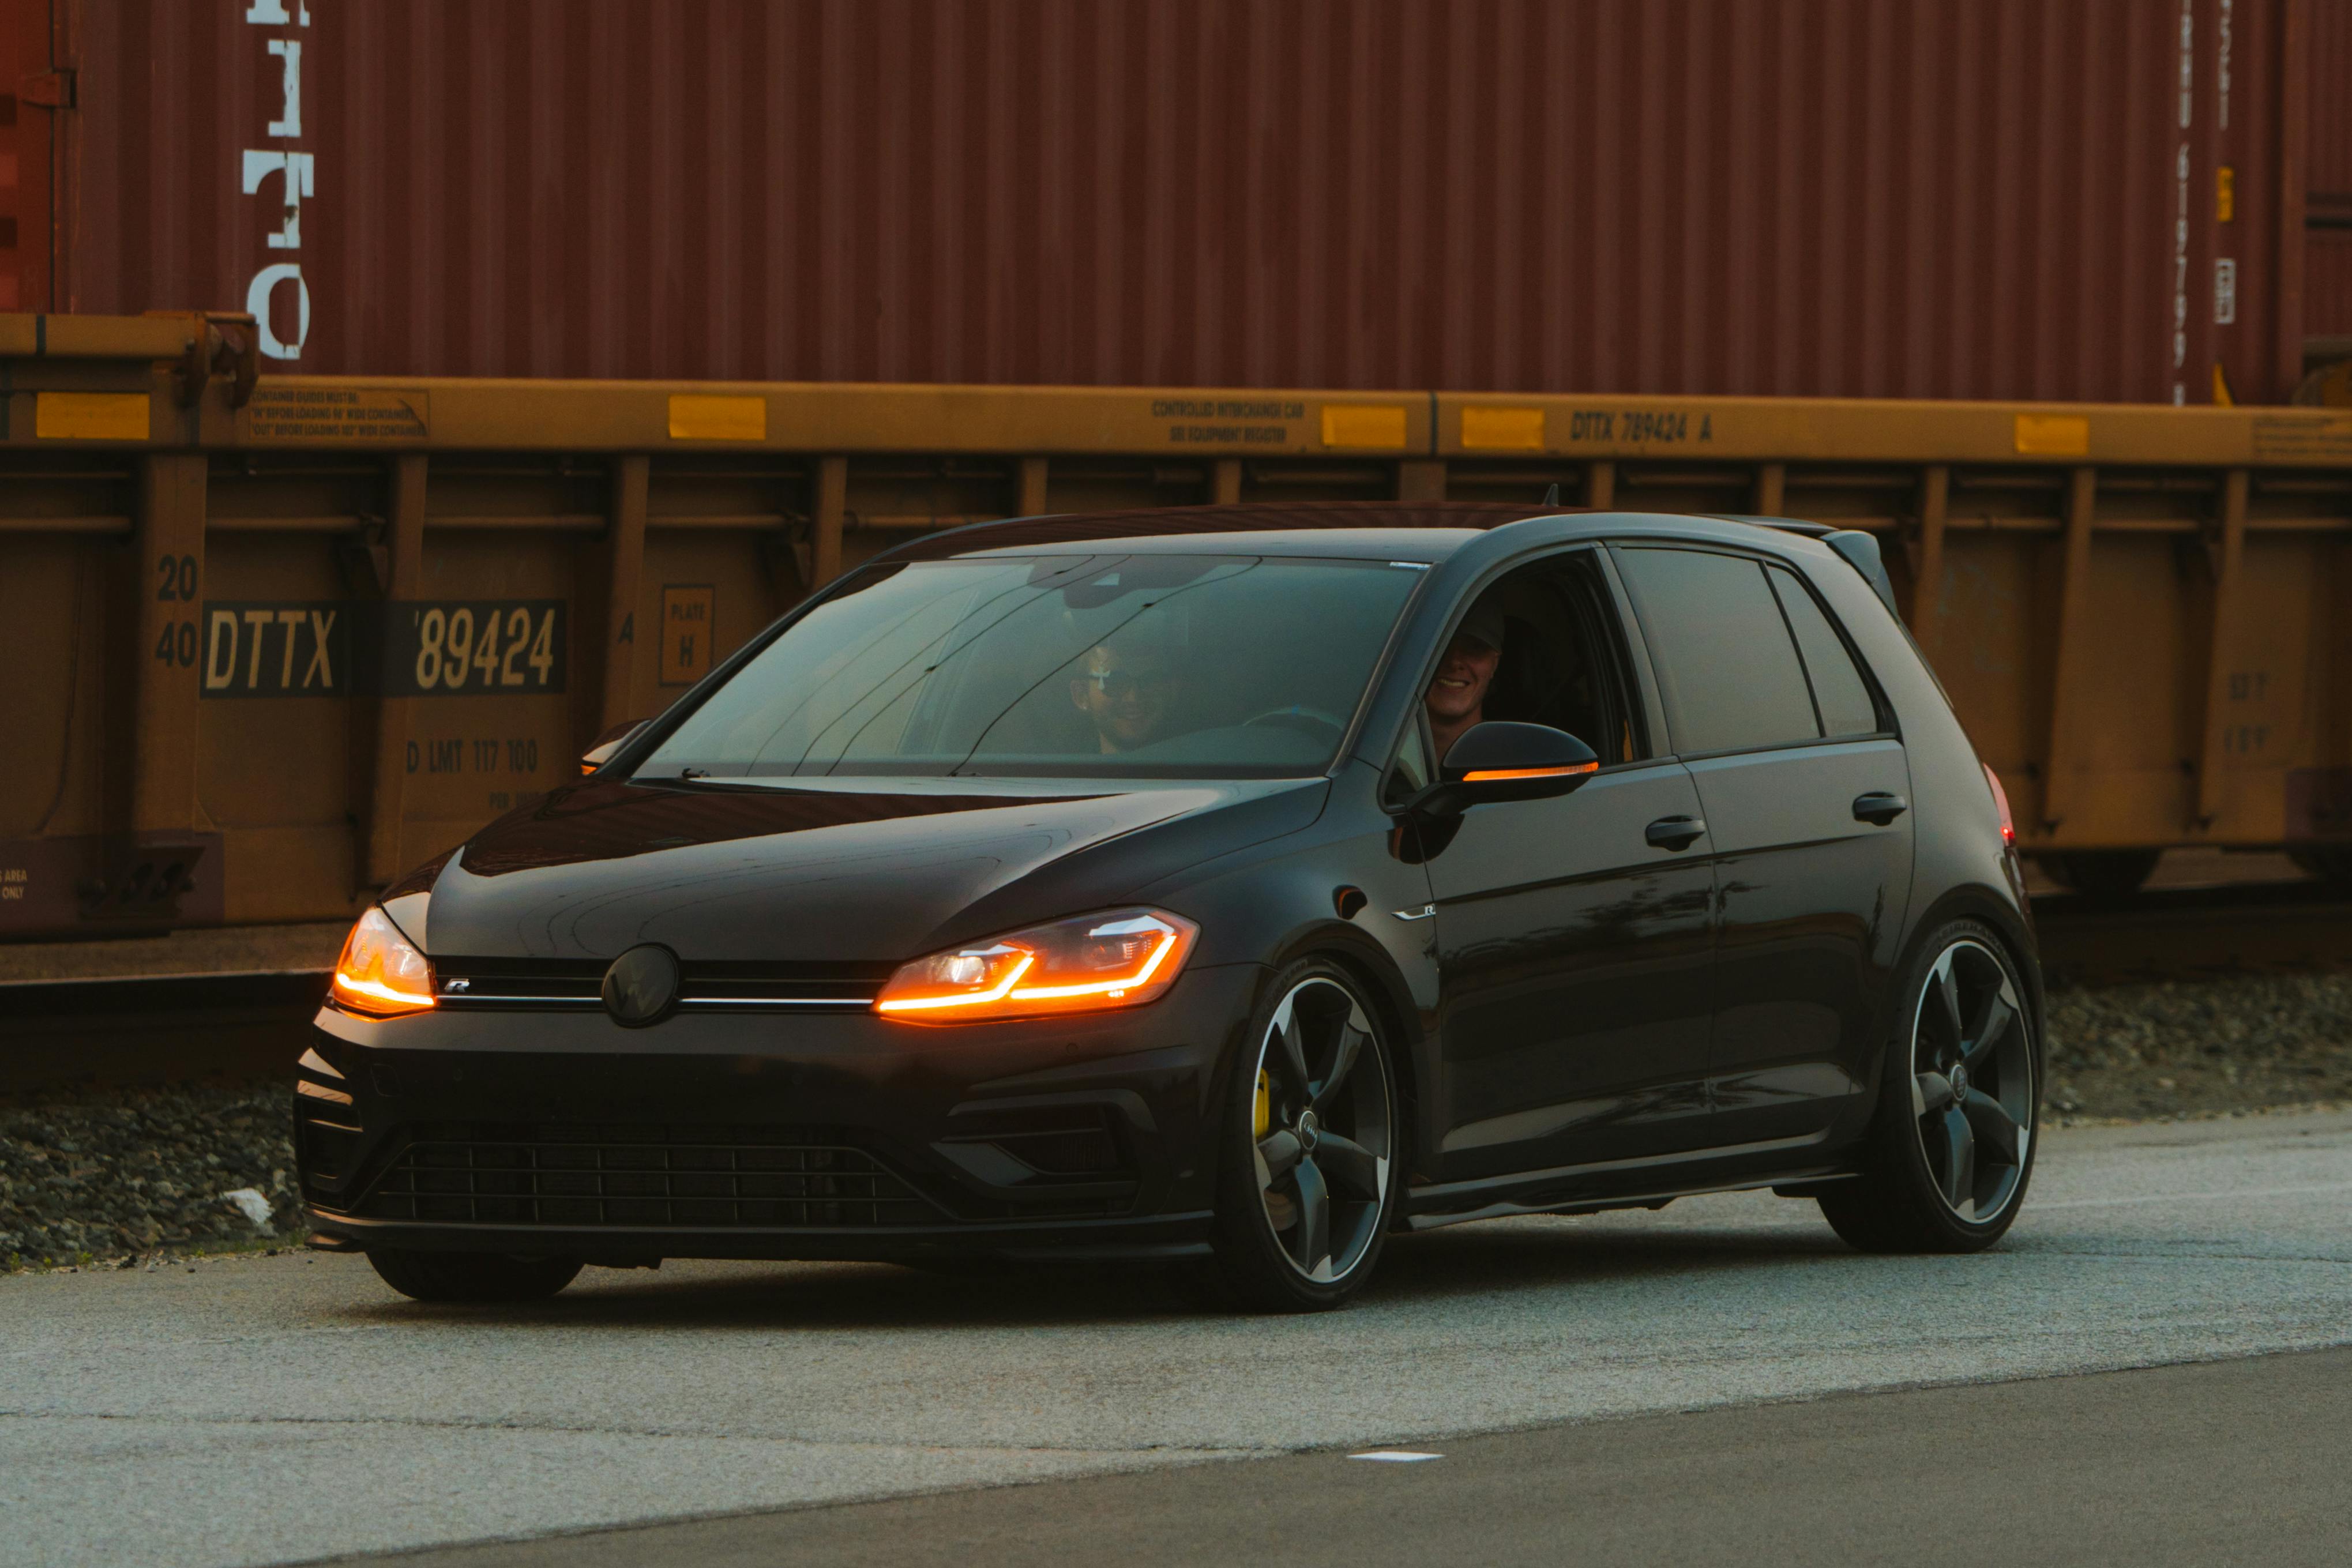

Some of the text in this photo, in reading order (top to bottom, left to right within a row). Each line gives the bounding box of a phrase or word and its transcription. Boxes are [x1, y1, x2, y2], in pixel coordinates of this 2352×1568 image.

[1569, 409, 1712, 442] DTTX 789424 A
[157, 553, 197, 602] 20
[671, 602, 704, 621] PLATE
[155, 621, 197, 668] 40
[205, 607, 634, 690] DTTX 89424 A
[679, 634, 694, 668] H
[406, 738, 538, 774] D LMT 117 100
[5, 867, 28, 882] AREA
[2, 885, 24, 900] ONLY
[444, 977, 470, 993] R
